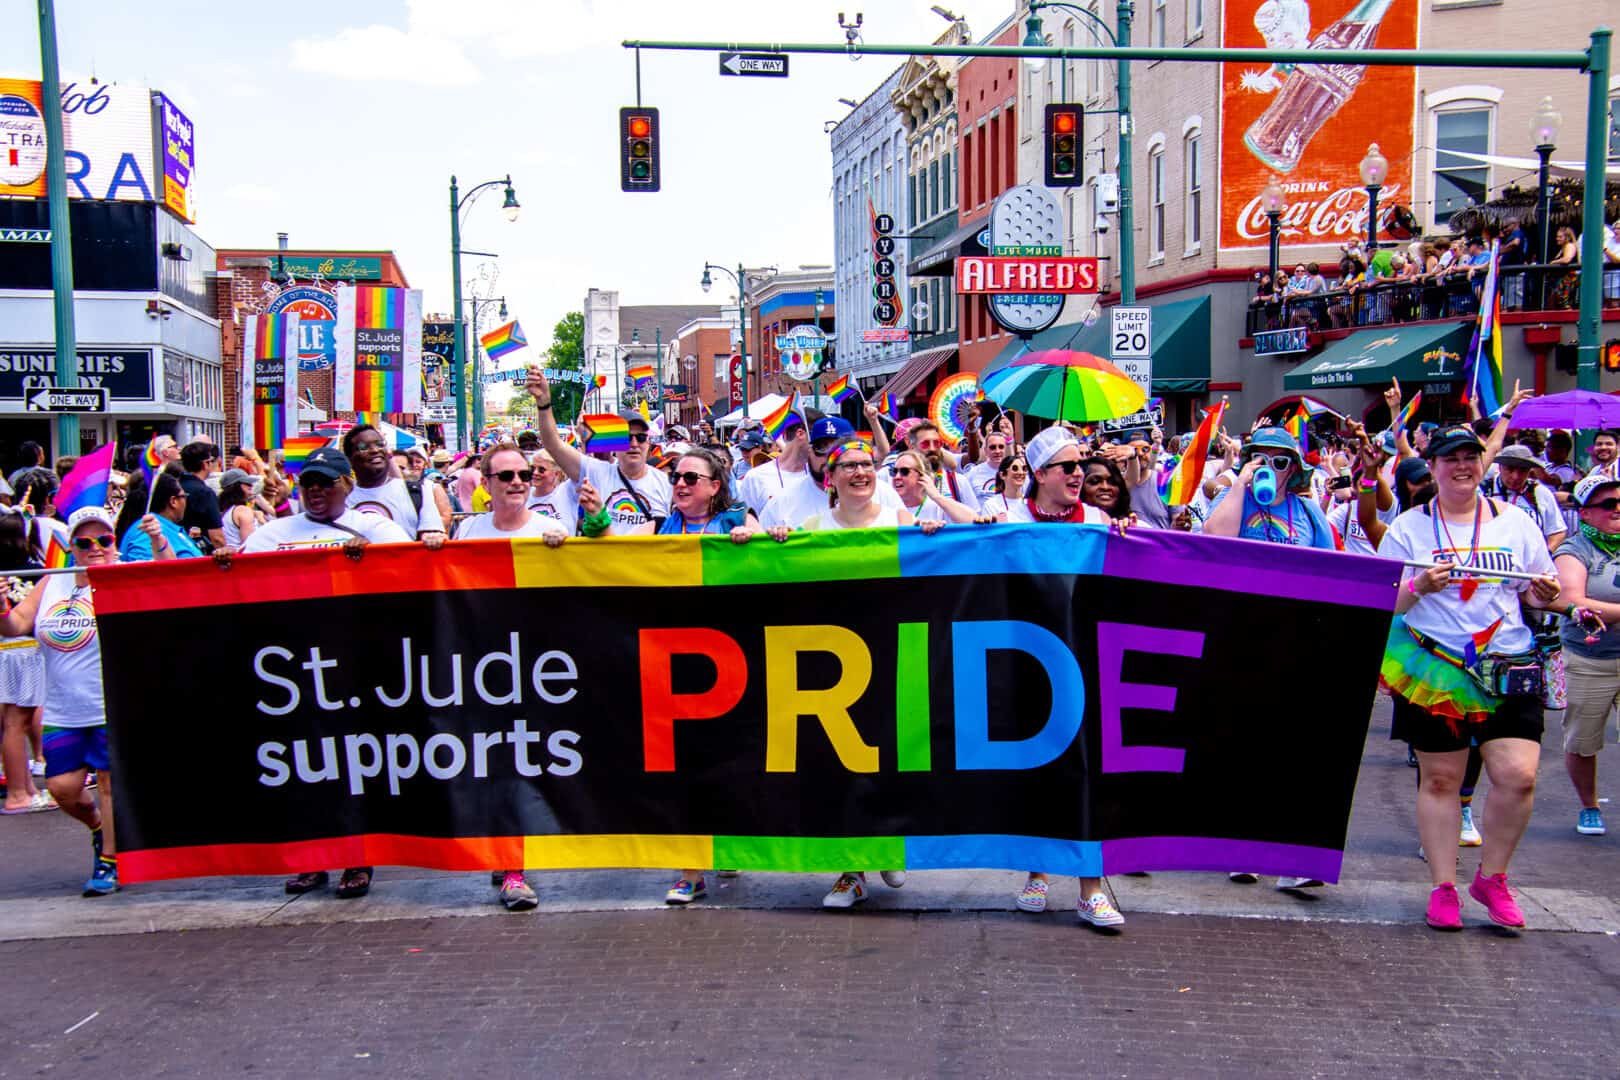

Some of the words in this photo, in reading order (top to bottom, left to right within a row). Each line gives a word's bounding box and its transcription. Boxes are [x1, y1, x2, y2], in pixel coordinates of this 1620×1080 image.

[740, 59, 759, 70] ONE
[762, 60, 782, 70] WAY
[1280, 182, 1329, 193] DRINK
[997, 247, 1020, 255] LIVE
[1025, 247, 1060, 255] MUSIC
[962, 259, 1094, 290] ALFRED'S
[1114, 312, 1148, 321] SPEED
[1118, 323, 1144, 331] LIMIT
[374, 332, 400, 342] Jude
[1115, 332, 1147, 351] 20
[358, 344, 400, 352] supports
[357, 353, 401, 366] PRIDE
[1125, 364, 1138, 372] NO
[22, 375, 104, 388] CADY
[1311, 374, 1328, 385] Drinks
[1328, 373, 1336, 383] On
[1336, 372, 1345, 382] The
[1345, 371, 1353, 382] Go
[49, 395, 72, 405] ONE
[75, 395, 97, 405] WAY
[1121, 414, 1137, 424] ONE
[1139, 411, 1156, 421] WAY
[619, 514, 647, 525] PRID
[254, 646, 361, 716] St.
[375, 632, 578, 708] Jude
[638, 620, 1206, 773] PRIDE
[257, 720, 583, 796] supports
